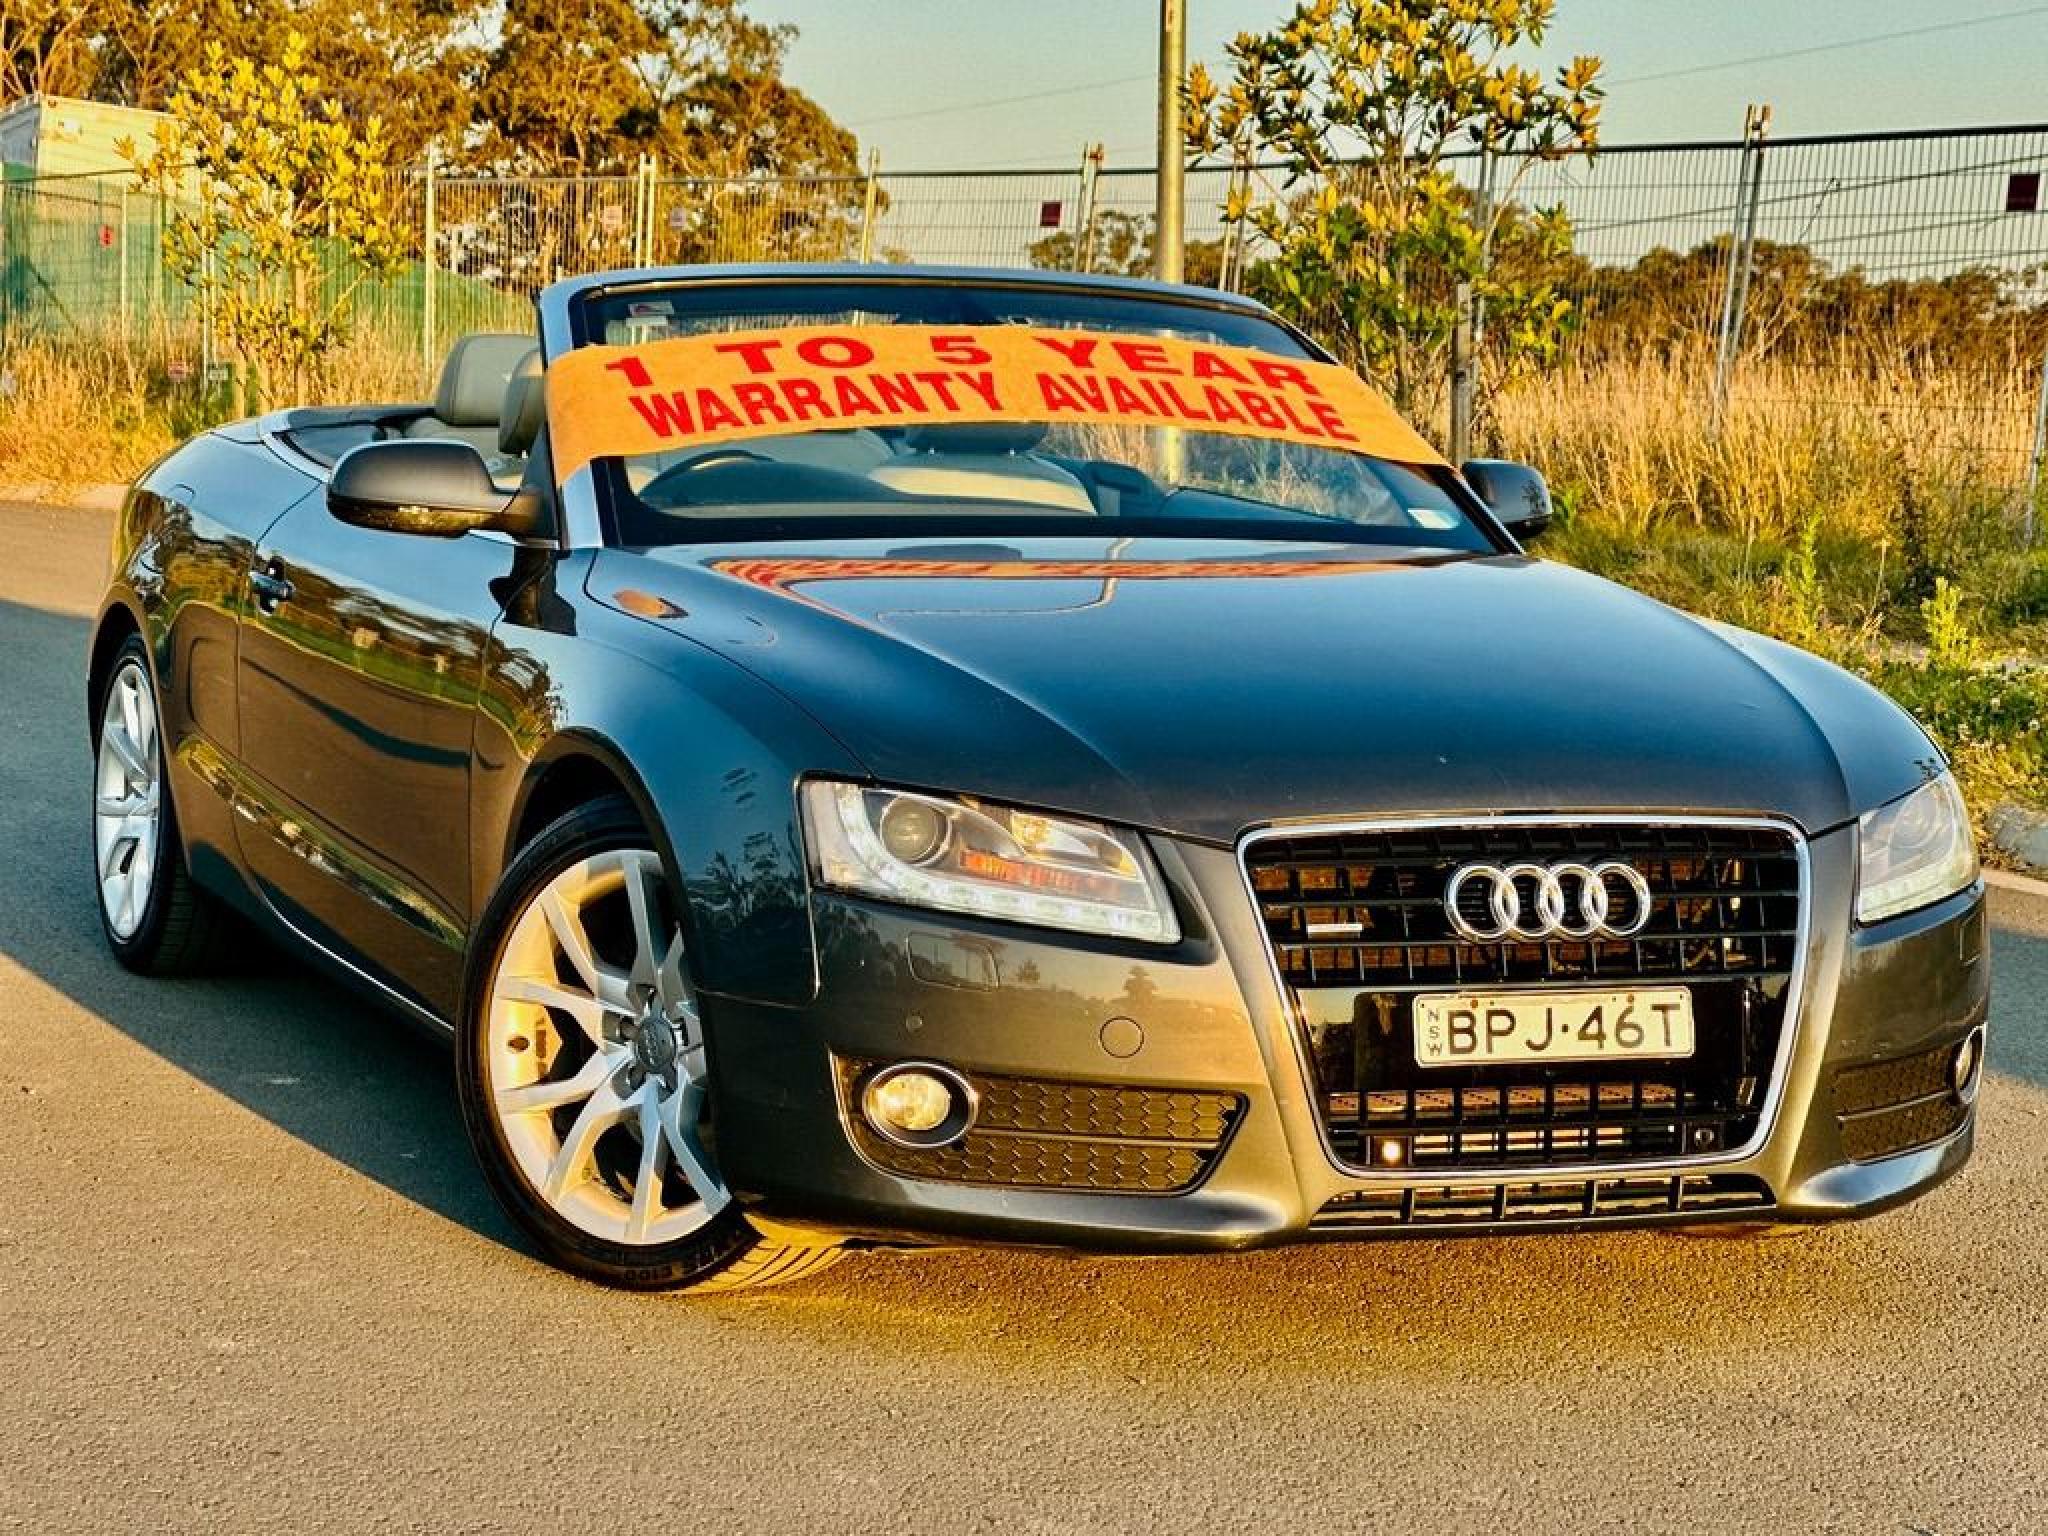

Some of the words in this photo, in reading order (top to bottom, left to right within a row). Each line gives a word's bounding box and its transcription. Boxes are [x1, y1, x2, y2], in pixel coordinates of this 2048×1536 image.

[604, 355, 653, 389] 1
[714, 335, 875, 375] TO
[929, 335, 994, 366] 5
[1034, 336, 1322, 397] YEAR
[626, 370, 1004, 440] WARRANTY
[1035, 372, 1359, 443] AVAILABLE
